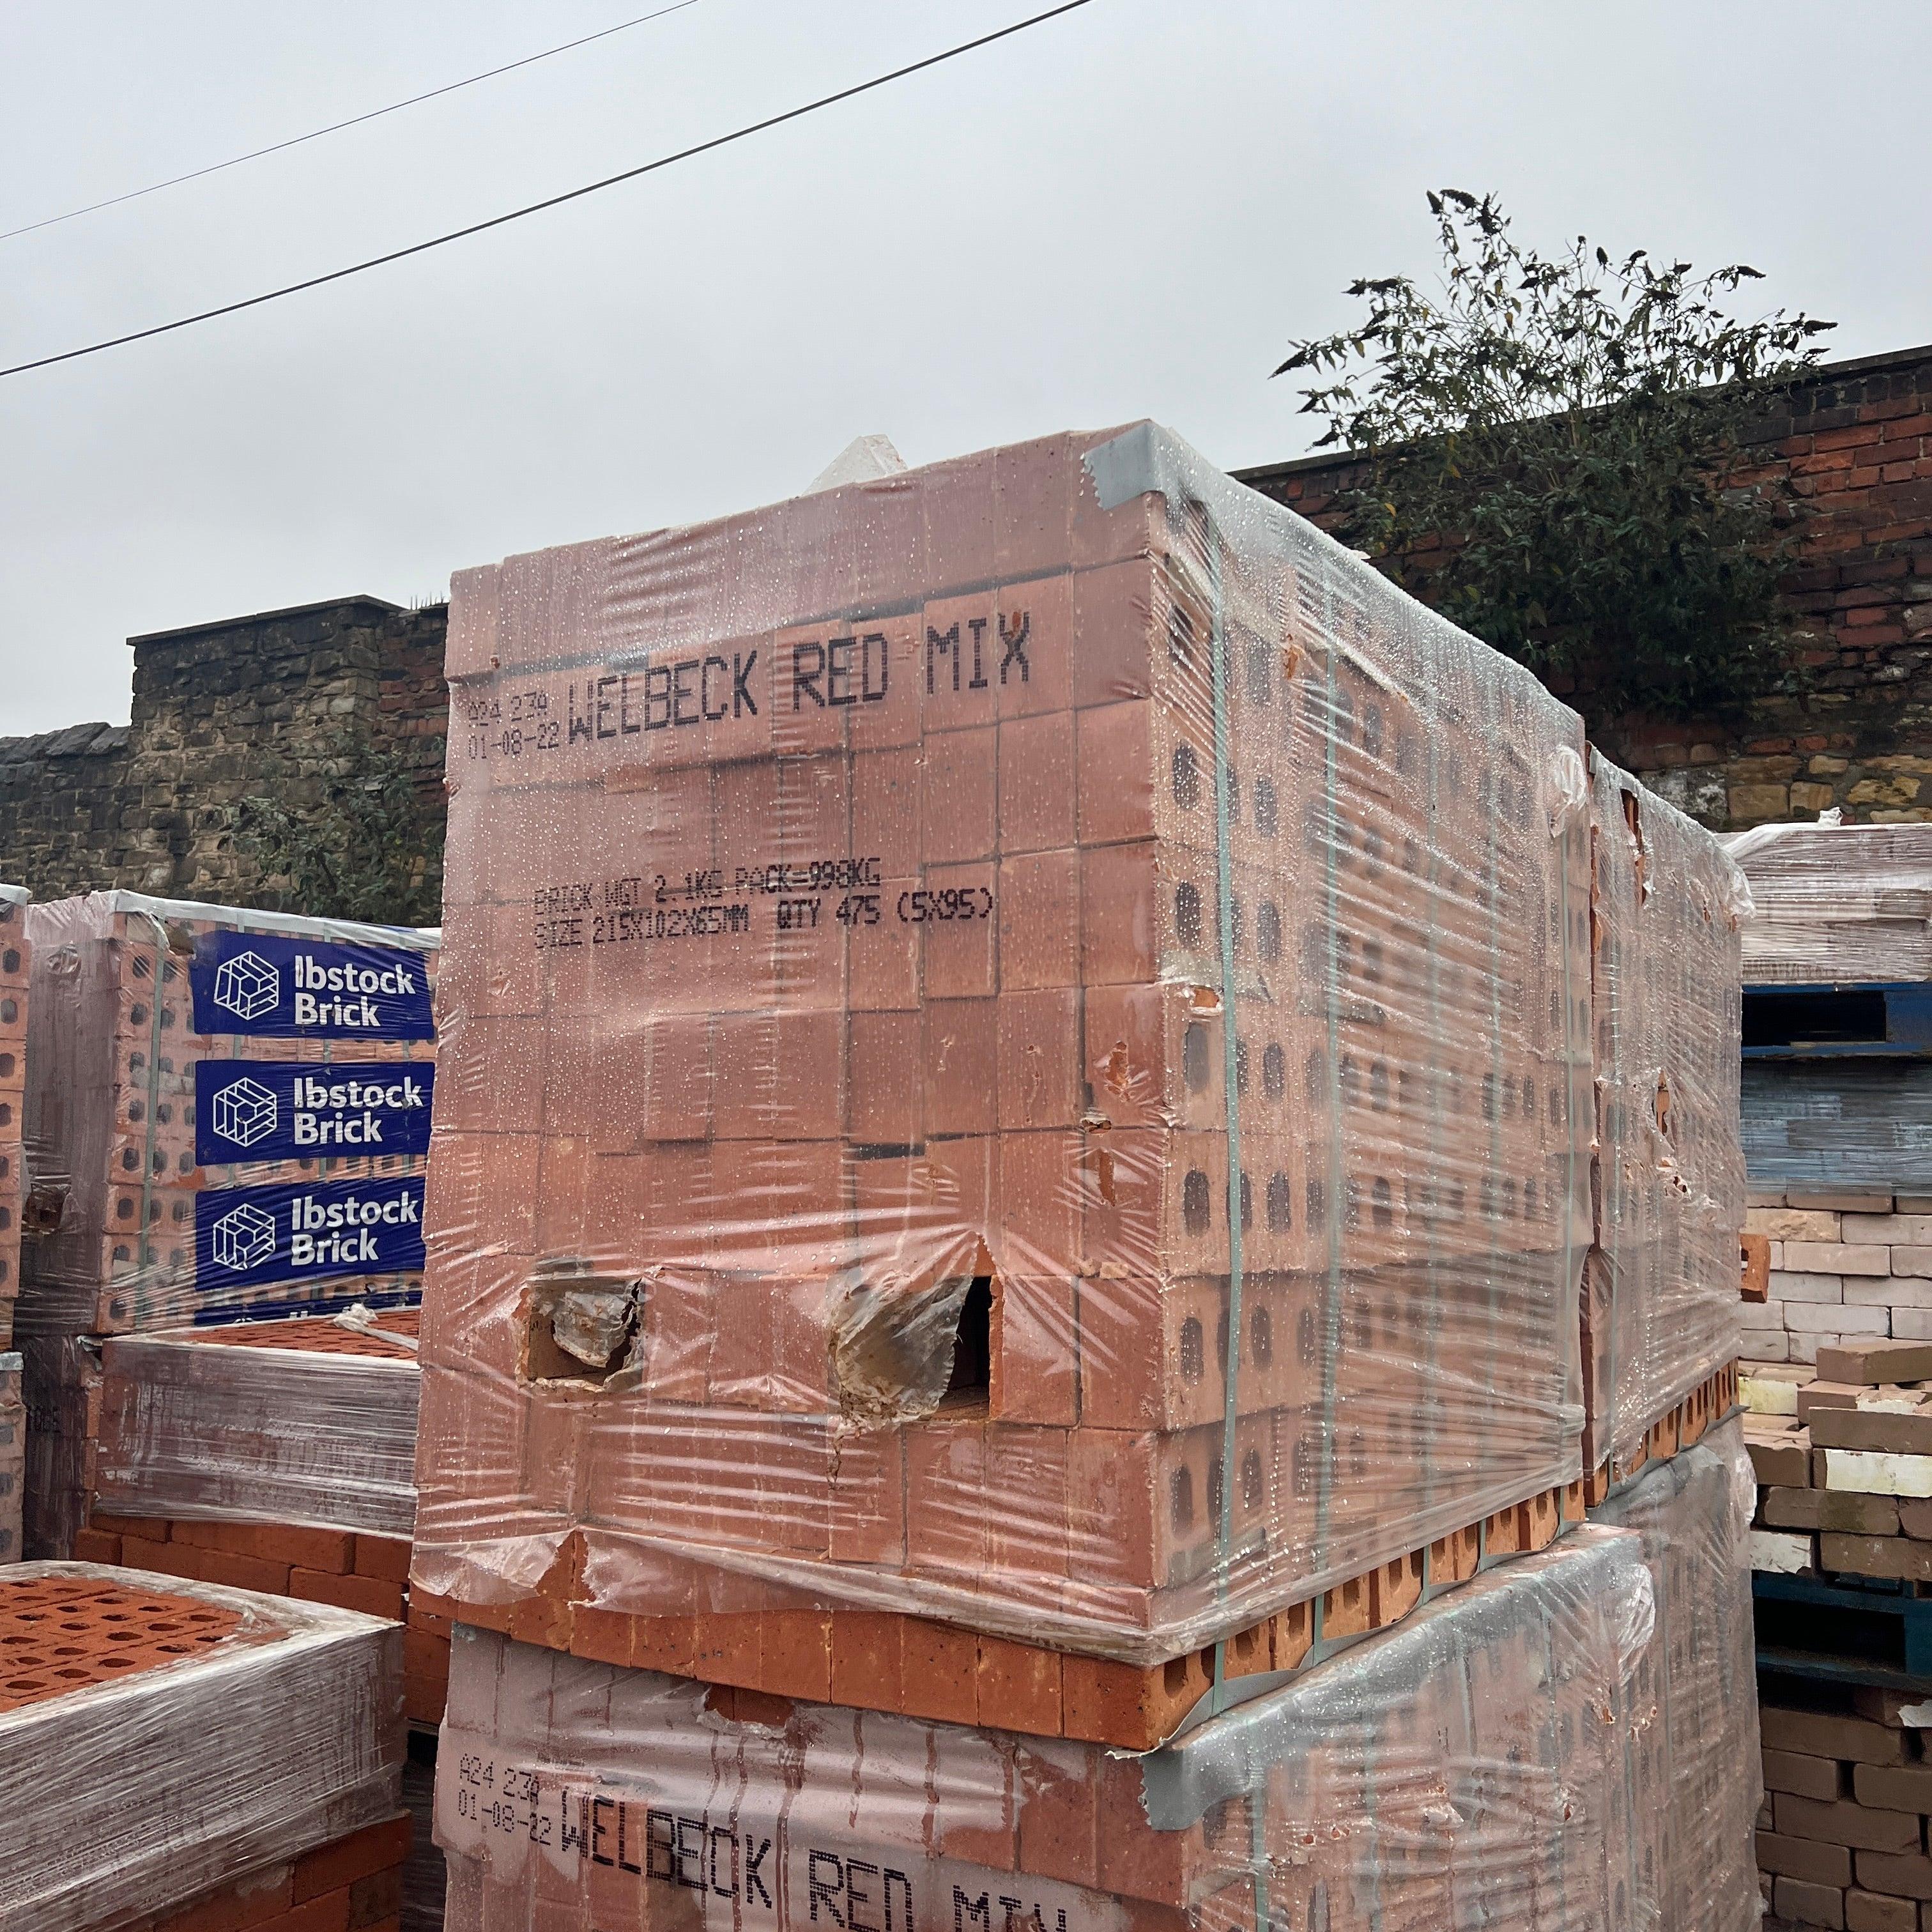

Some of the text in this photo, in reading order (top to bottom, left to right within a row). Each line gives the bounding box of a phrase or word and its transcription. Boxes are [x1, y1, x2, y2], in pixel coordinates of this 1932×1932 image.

[567, 611, 1030, 746] WELBECK RED MIX
[468, 721, 560, 760] 01-08-22
[534, 882, 593, 916] BRICK
[534, 887, 993, 949] SIZE 215X102X65MM QTY 475 (5X95)
[295, 954, 417, 995] Ibstock
[295, 992, 381, 1027] Brick
[294, 1076, 425, 1109] Ibstock
[294, 1111, 383, 1146] Brick
[291, 1191, 419, 1231] Ibstock
[291, 1227, 379, 1266] Brick
[460, 1753, 494, 1789] A24
[458, 1789, 551, 1846] 01-08-22
[561, 1786, 772, 1908] WELBECK
[808, 1848, 915, 1932] RED
